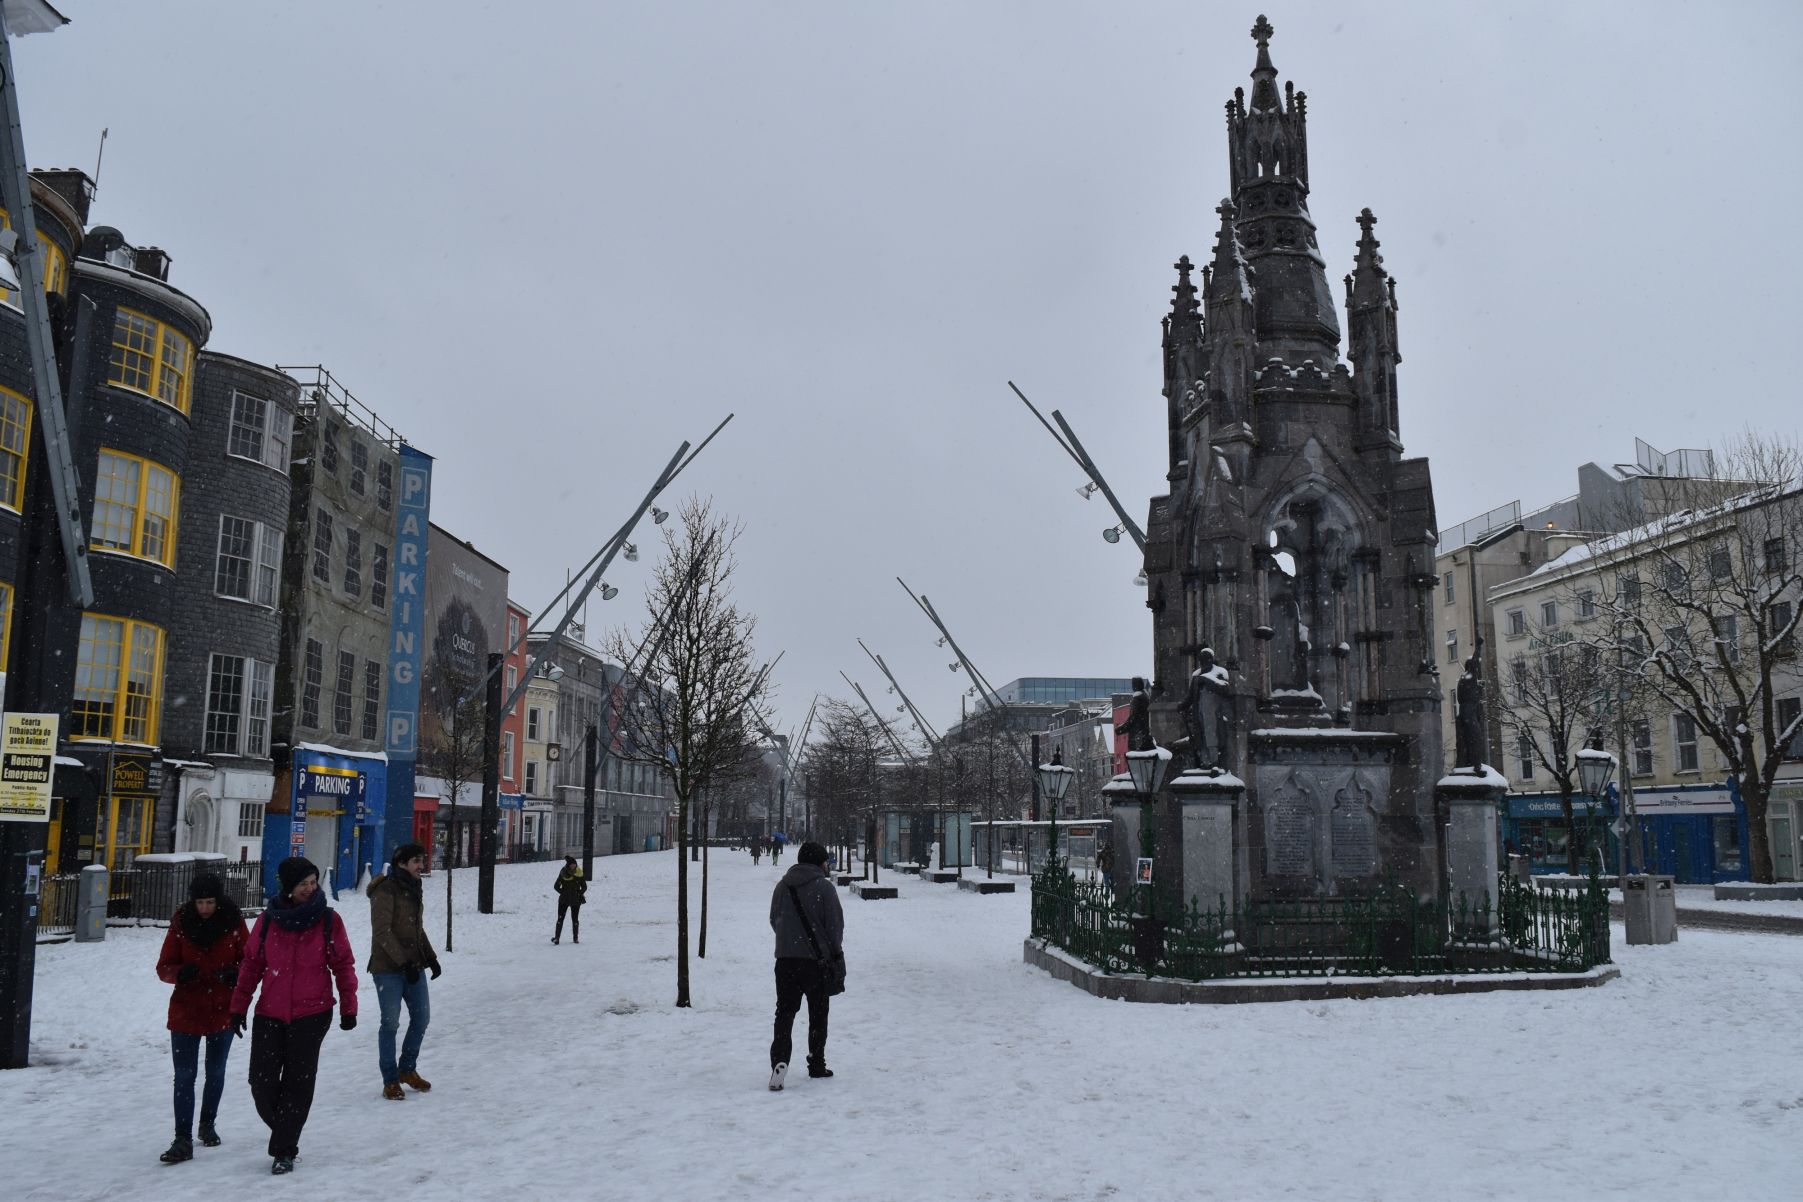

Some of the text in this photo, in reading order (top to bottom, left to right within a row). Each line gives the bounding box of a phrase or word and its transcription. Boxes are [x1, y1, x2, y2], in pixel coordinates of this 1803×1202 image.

[394, 473, 422, 684] PARKING
[21, 717, 41, 726] Cearta
[391, 717, 409, 745] P
[11, 754, 43, 768] Housing
[3, 768, 48, 782] Emergency
[115, 770, 144, 780] POWELL
[315, 776, 350, 795] PARKING
